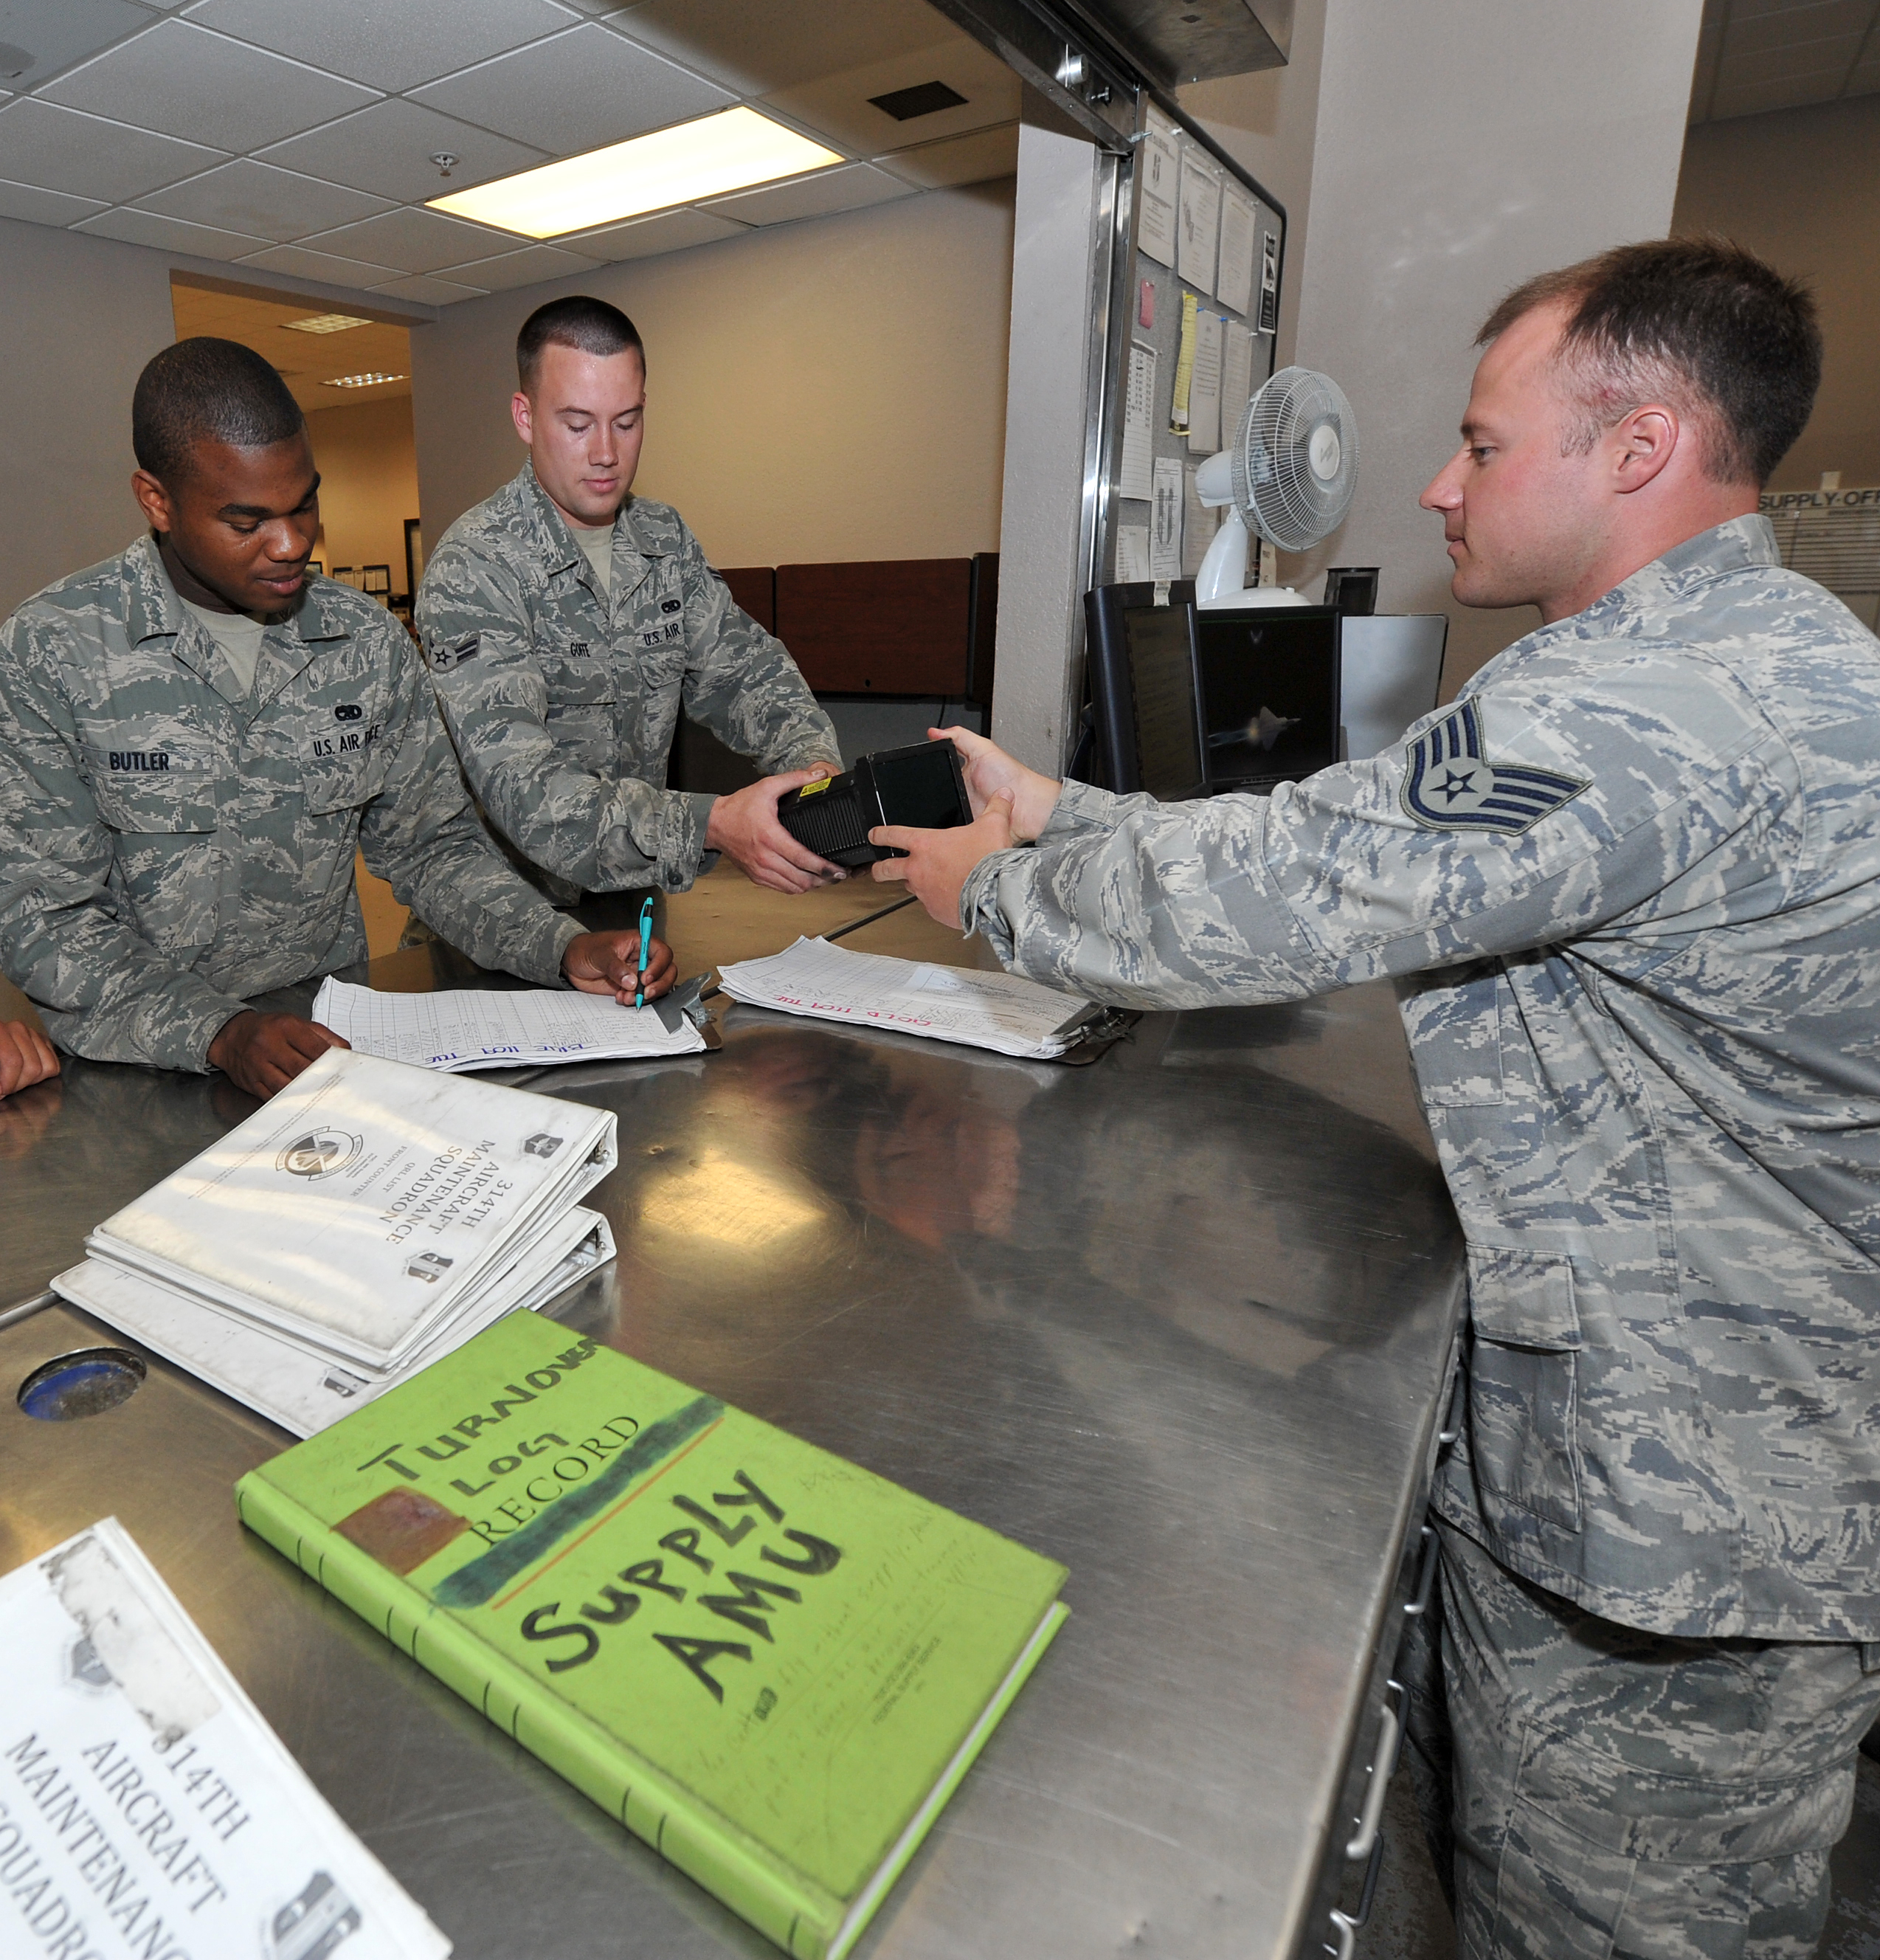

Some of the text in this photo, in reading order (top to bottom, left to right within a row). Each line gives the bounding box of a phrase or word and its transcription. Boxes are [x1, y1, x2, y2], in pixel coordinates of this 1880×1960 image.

[1758, 492, 1839, 511] SUPPLY
[643, 623, 680, 646] U.S. AIR
[109, 752, 170, 770] BUTLER
[314, 739, 336, 756] U.S.
[340, 734, 361, 752] AIR
[867, 1011, 931, 1026] GOLD
[350, 1166, 386, 1198] COUNTER
[379, 1145, 463, 1224] SQUADRON
[381, 1175, 402, 1194] LIST
[382, 1145, 408, 1169] FRONT
[385, 1139, 497, 1245] MAINTENANCE
[428, 1161, 500, 1235] AIRCRAFT
[461, 1179, 514, 1229] 314TH
[356, 1337, 598, 1482] TURNOVER
[449, 1432, 570, 1497] LOG
[469, 1415, 640, 1547] RECORD
[651, 1528, 843, 1707] AMU
[5, 1733, 194, 1960] MAINTENAN
[81, 1740, 228, 1914] AIRCRAFT
